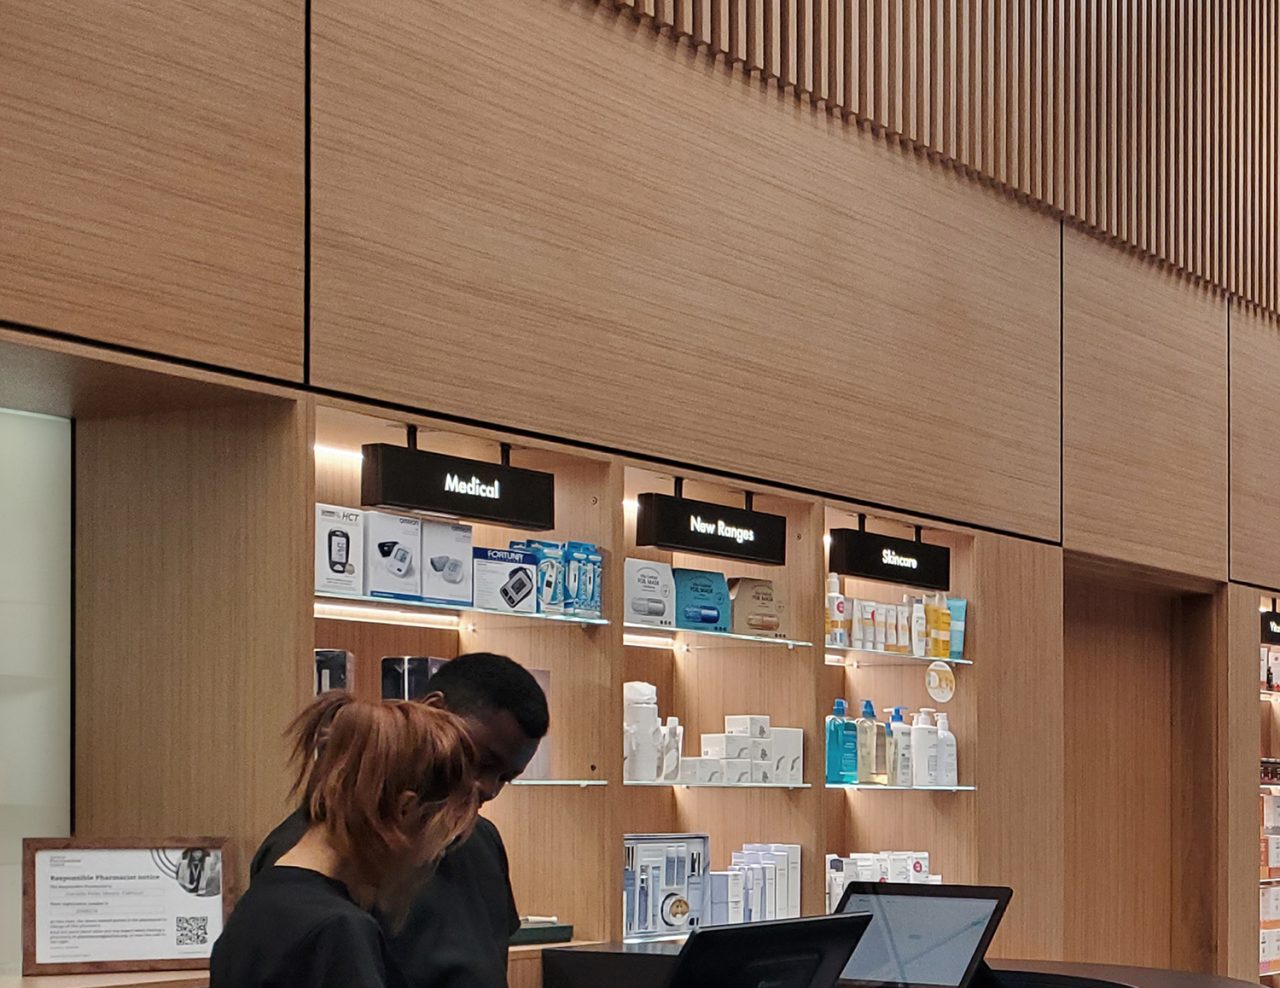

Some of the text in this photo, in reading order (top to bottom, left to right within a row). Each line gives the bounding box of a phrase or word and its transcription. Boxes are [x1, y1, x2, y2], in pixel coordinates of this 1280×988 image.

[444, 473, 500, 499] Medical
[341, 511, 359, 522] HCT
[690, 515, 755, 544] New Ranges
[881, 549, 918, 570] Skincare
